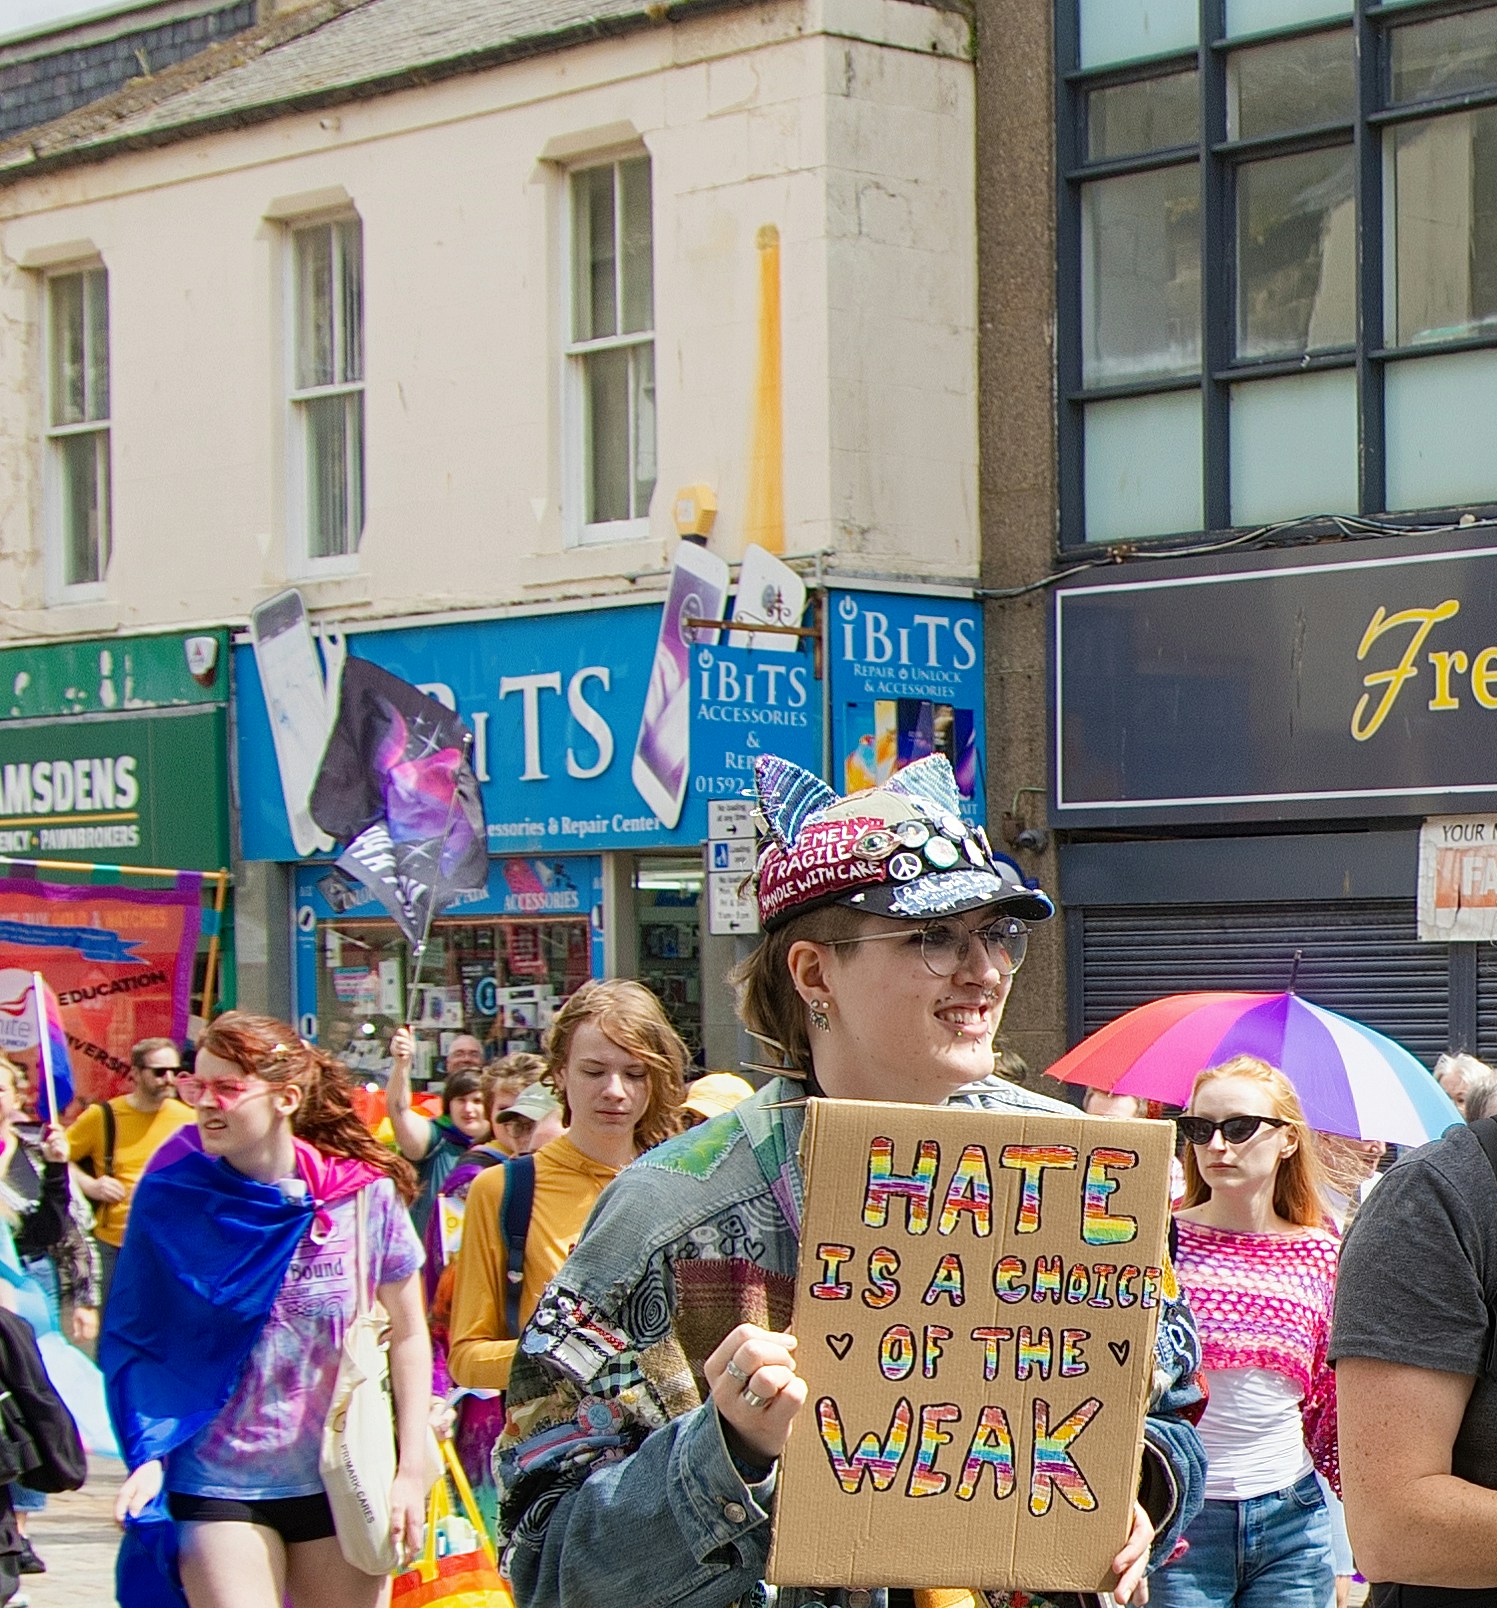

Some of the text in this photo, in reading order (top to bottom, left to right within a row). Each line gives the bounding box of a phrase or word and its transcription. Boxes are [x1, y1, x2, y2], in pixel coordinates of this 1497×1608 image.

[864, 680, 955, 698] & ACCESSORIES
[911, 669, 963, 684] UNLOCK
[697, 705, 808, 727] ACCESSORIES
[746, 731, 761, 749] &
[695, 776, 745, 794] 01592
[40, 824, 141, 850] PAWNBROKERS
[487, 813, 661, 838] essories & Repair Center
[797, 824, 870, 851] EMELY
[1442, 823, 1484, 844] YOUR
[766, 840, 852, 887] FRAGILE
[760, 860, 882, 911] HANDLE WITH CARE
[503, 890, 580, 912] ACCESSORIES
[58, 970, 167, 1006] EDUCATION
[861, 1135, 1139, 1246] HATE
[290, 1257, 344, 1282] Bound
[809, 1242, 1163, 1310] IS A CHOICE
[878, 1322, 1091, 1382] OF THE
[814, 1395, 1104, 1517] WEAK
[340, 1443, 375, 1525] PRIMARK CARES
